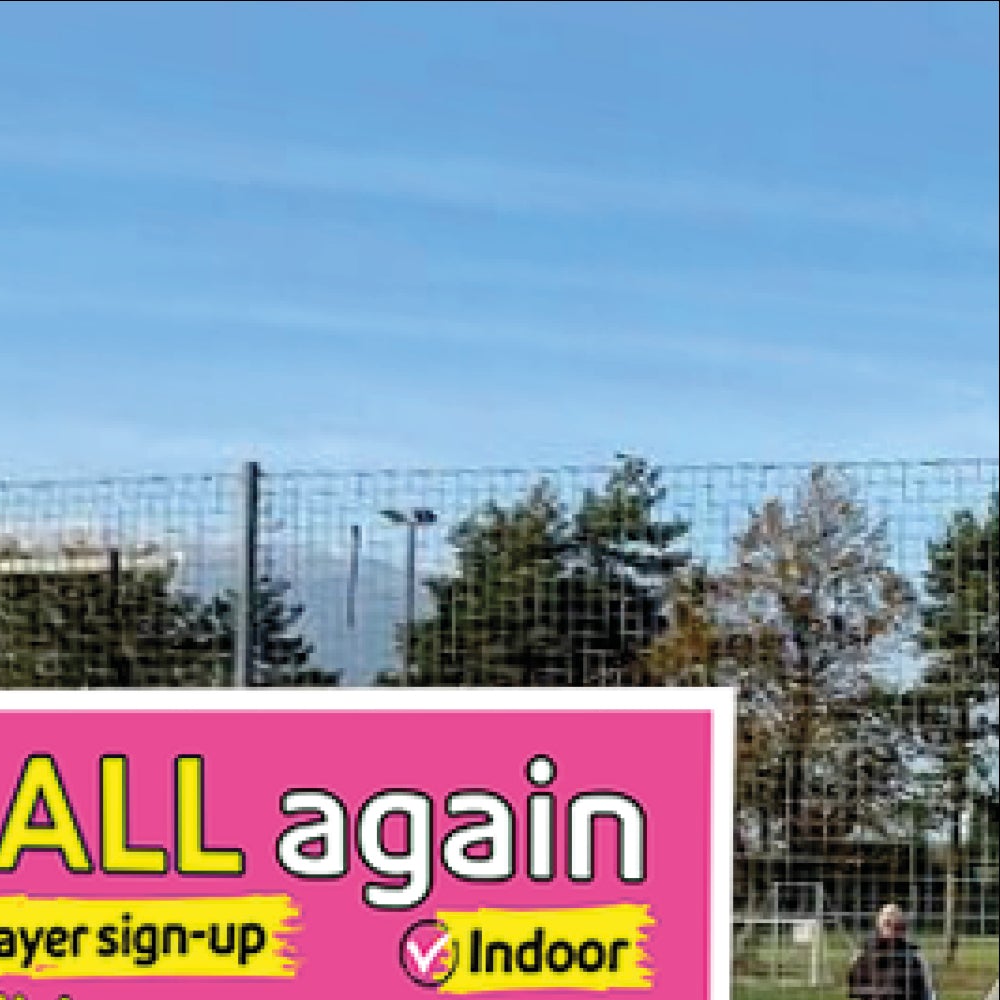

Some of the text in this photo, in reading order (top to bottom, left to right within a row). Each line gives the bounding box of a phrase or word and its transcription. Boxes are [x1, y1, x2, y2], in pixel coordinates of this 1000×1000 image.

[276, 754, 648, 910] again
[97, 912, 267, 966] sign-up
[469, 927, 630, 974] Indoor
